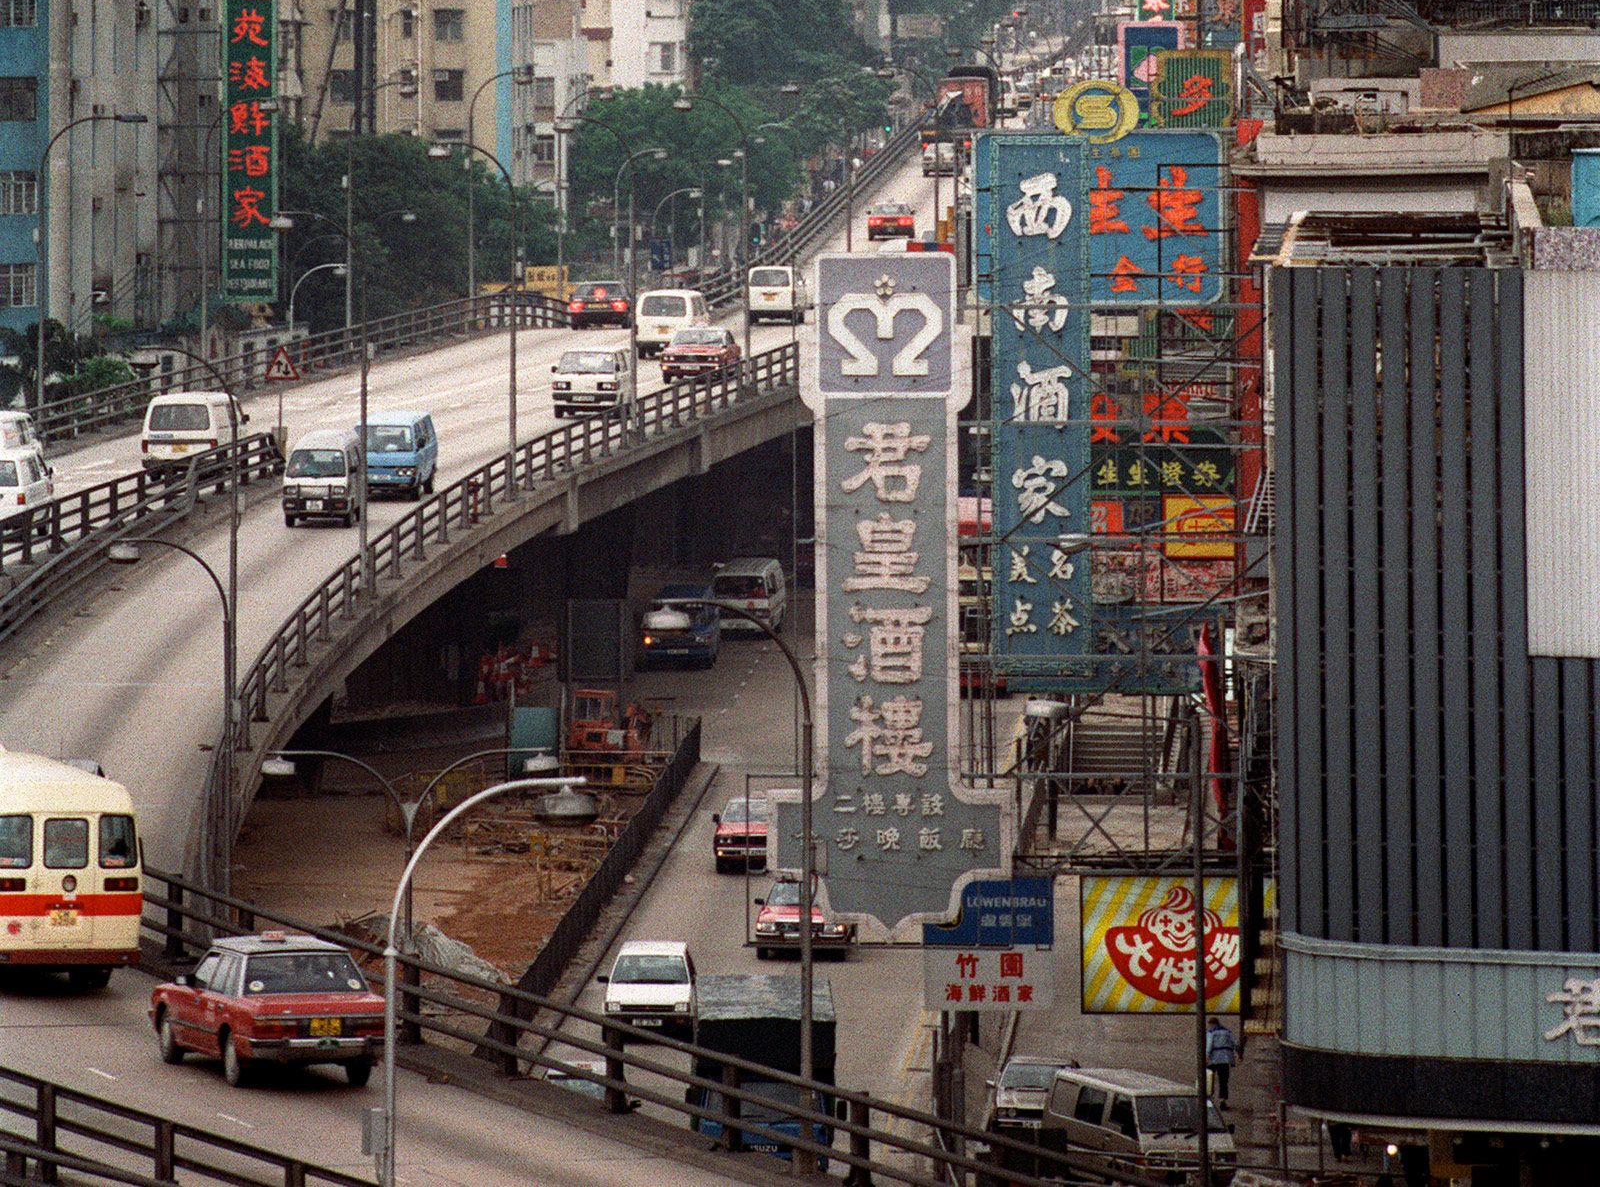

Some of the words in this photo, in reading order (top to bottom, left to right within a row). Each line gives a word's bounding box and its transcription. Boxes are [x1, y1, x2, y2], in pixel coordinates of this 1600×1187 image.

[1006, 172, 1073, 524] 西南酒家
[1108, 253, 1208, 293] 金行
[841, 421, 932, 779] 君皇酒樓
[944, 983, 1034, 1003] 海鮮酒家
